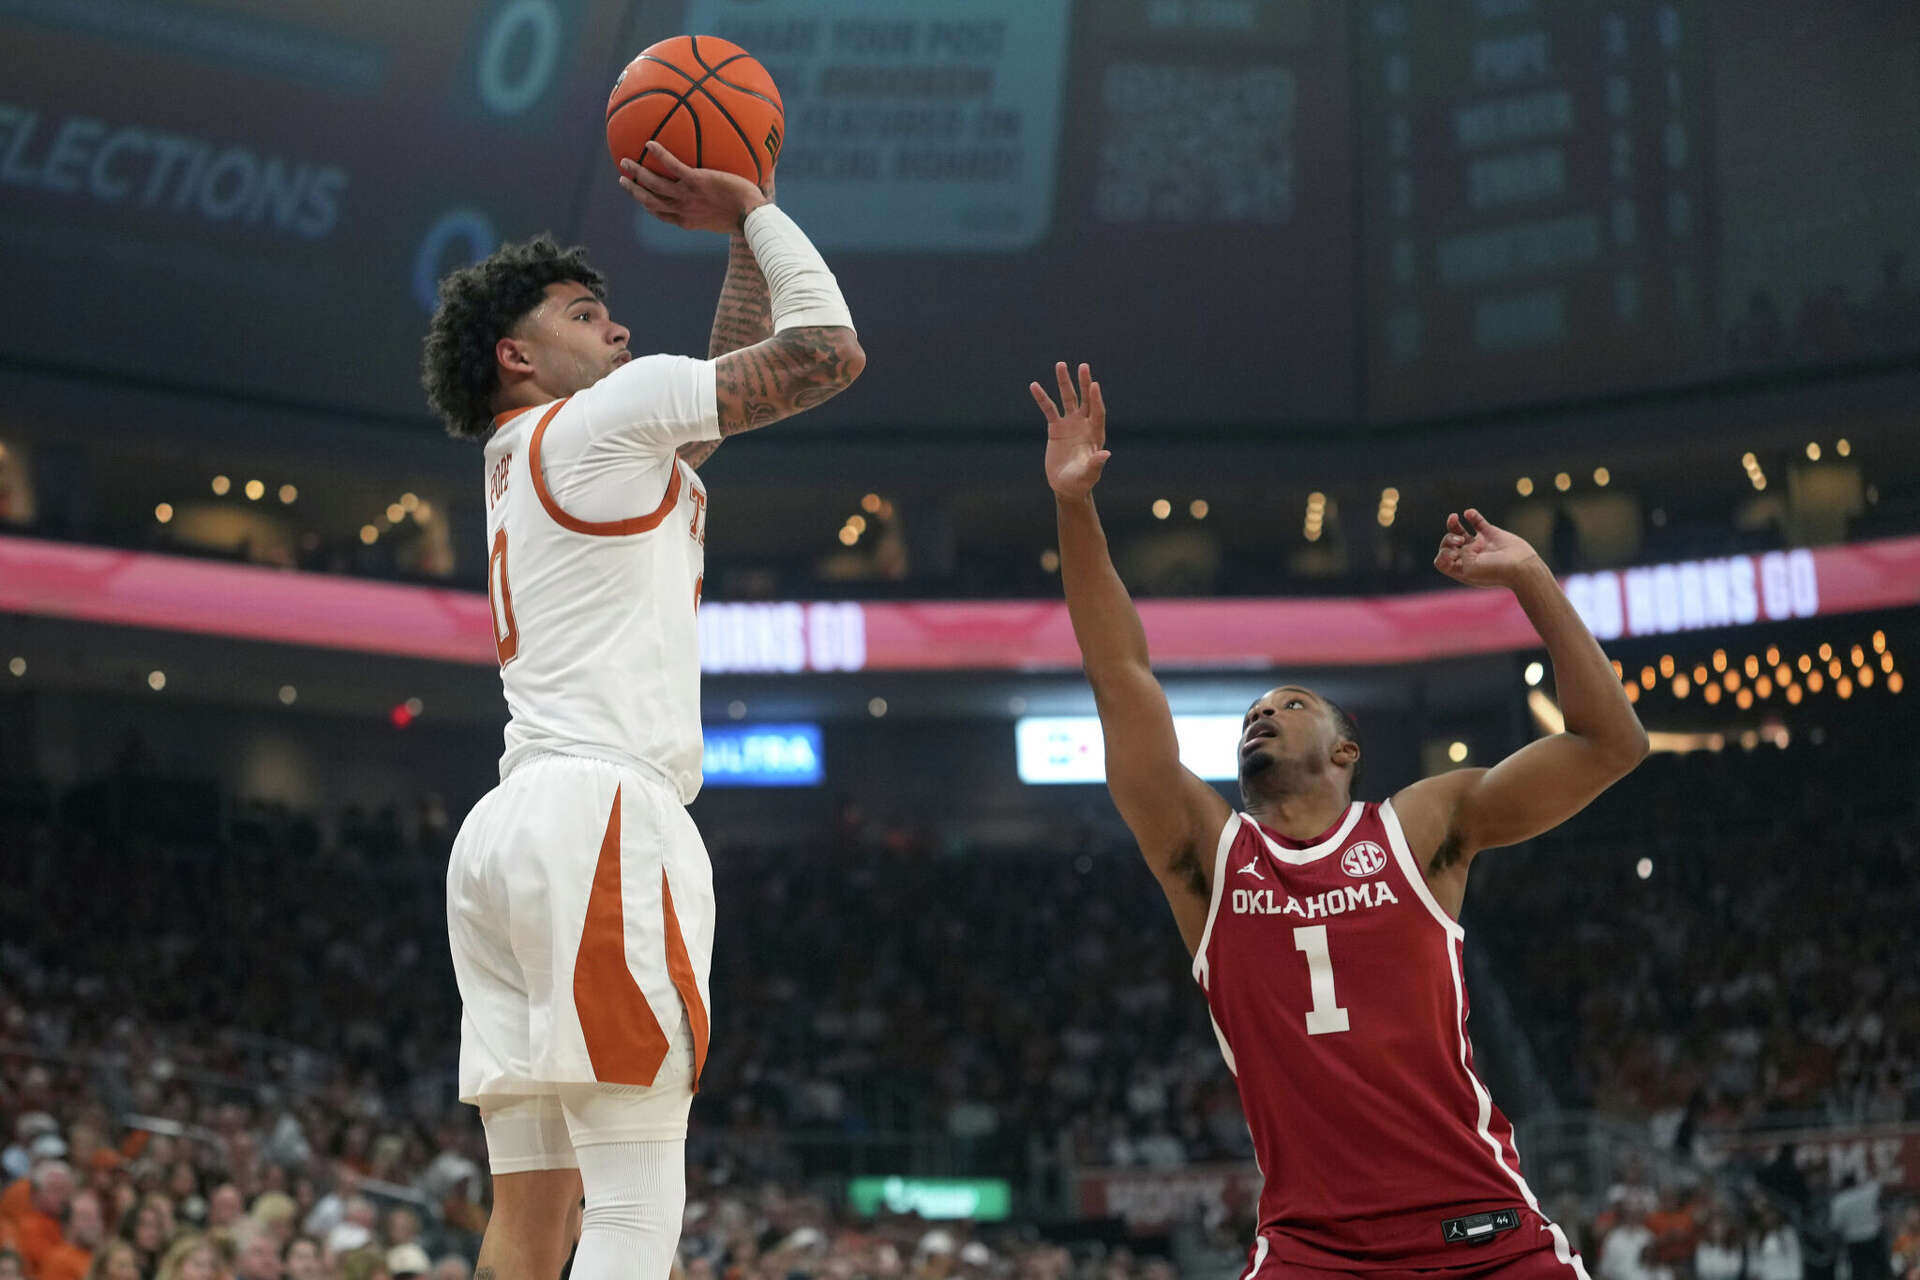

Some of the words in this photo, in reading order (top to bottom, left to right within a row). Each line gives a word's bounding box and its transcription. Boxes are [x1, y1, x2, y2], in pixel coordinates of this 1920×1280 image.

[480, 0, 560, 114] 0
[490, 452, 512, 512] POPE
[488, 526, 520, 672] 0
[1625, 556, 1757, 634] HORNS
[1761, 549, 1819, 619] GO
[808, 601, 867, 673] GO
[1343, 842, 1386, 876] SEC
[1232, 880, 1399, 920] OKLAHOMA
[1292, 924, 1351, 1036] 1
[1497, 1216, 1508, 1225] 44
